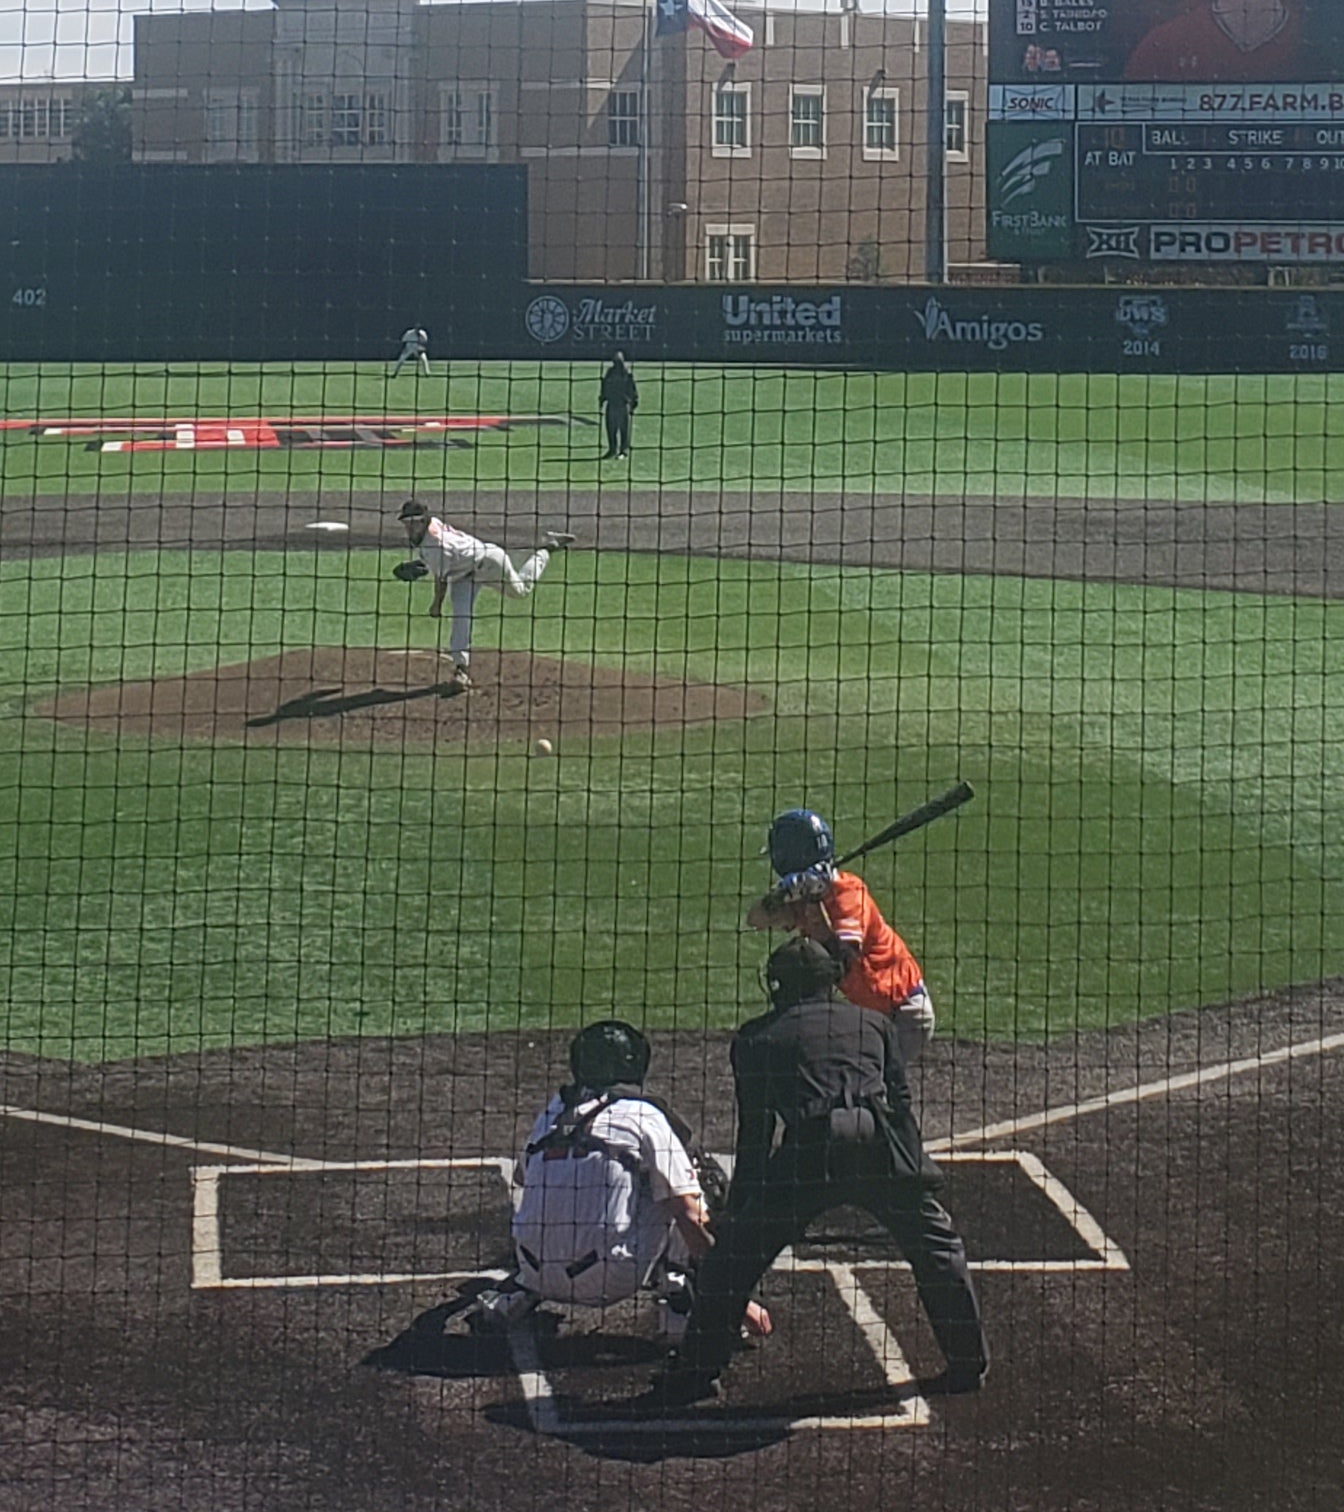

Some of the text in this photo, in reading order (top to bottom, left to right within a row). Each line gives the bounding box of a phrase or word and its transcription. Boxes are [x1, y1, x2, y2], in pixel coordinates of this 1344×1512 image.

[1020, 21, 1034, 31] 10
[1055, 20, 1102, 32] TALBOT
[1007, 97, 1055, 110] SONIC
[1228, 129, 1284, 145] STRIKE
[1084, 151, 1136, 166] AT BAT
[1170, 157, 1177, 170] 1
[1186, 157, 1196, 170] 2
[1203, 157, 1212, 170] 3
[1226, 157, 1236, 170] 4
[1243, 157, 1253, 170] 5
[1261, 157, 1271, 170] 6
[1285, 157, 1294, 170] 7
[1302, 157, 1312, 170] 8
[1319, 157, 1329, 170] 9
[12, 289, 47, 306] 402
[573, 298, 657, 324] Market
[722, 294, 842, 327] United
[573, 324, 656, 340] STREET
[723, 327, 842, 345] supermarkets
[936, 313, 1044, 350] Amigos
[1123, 339, 1161, 357] 2014
